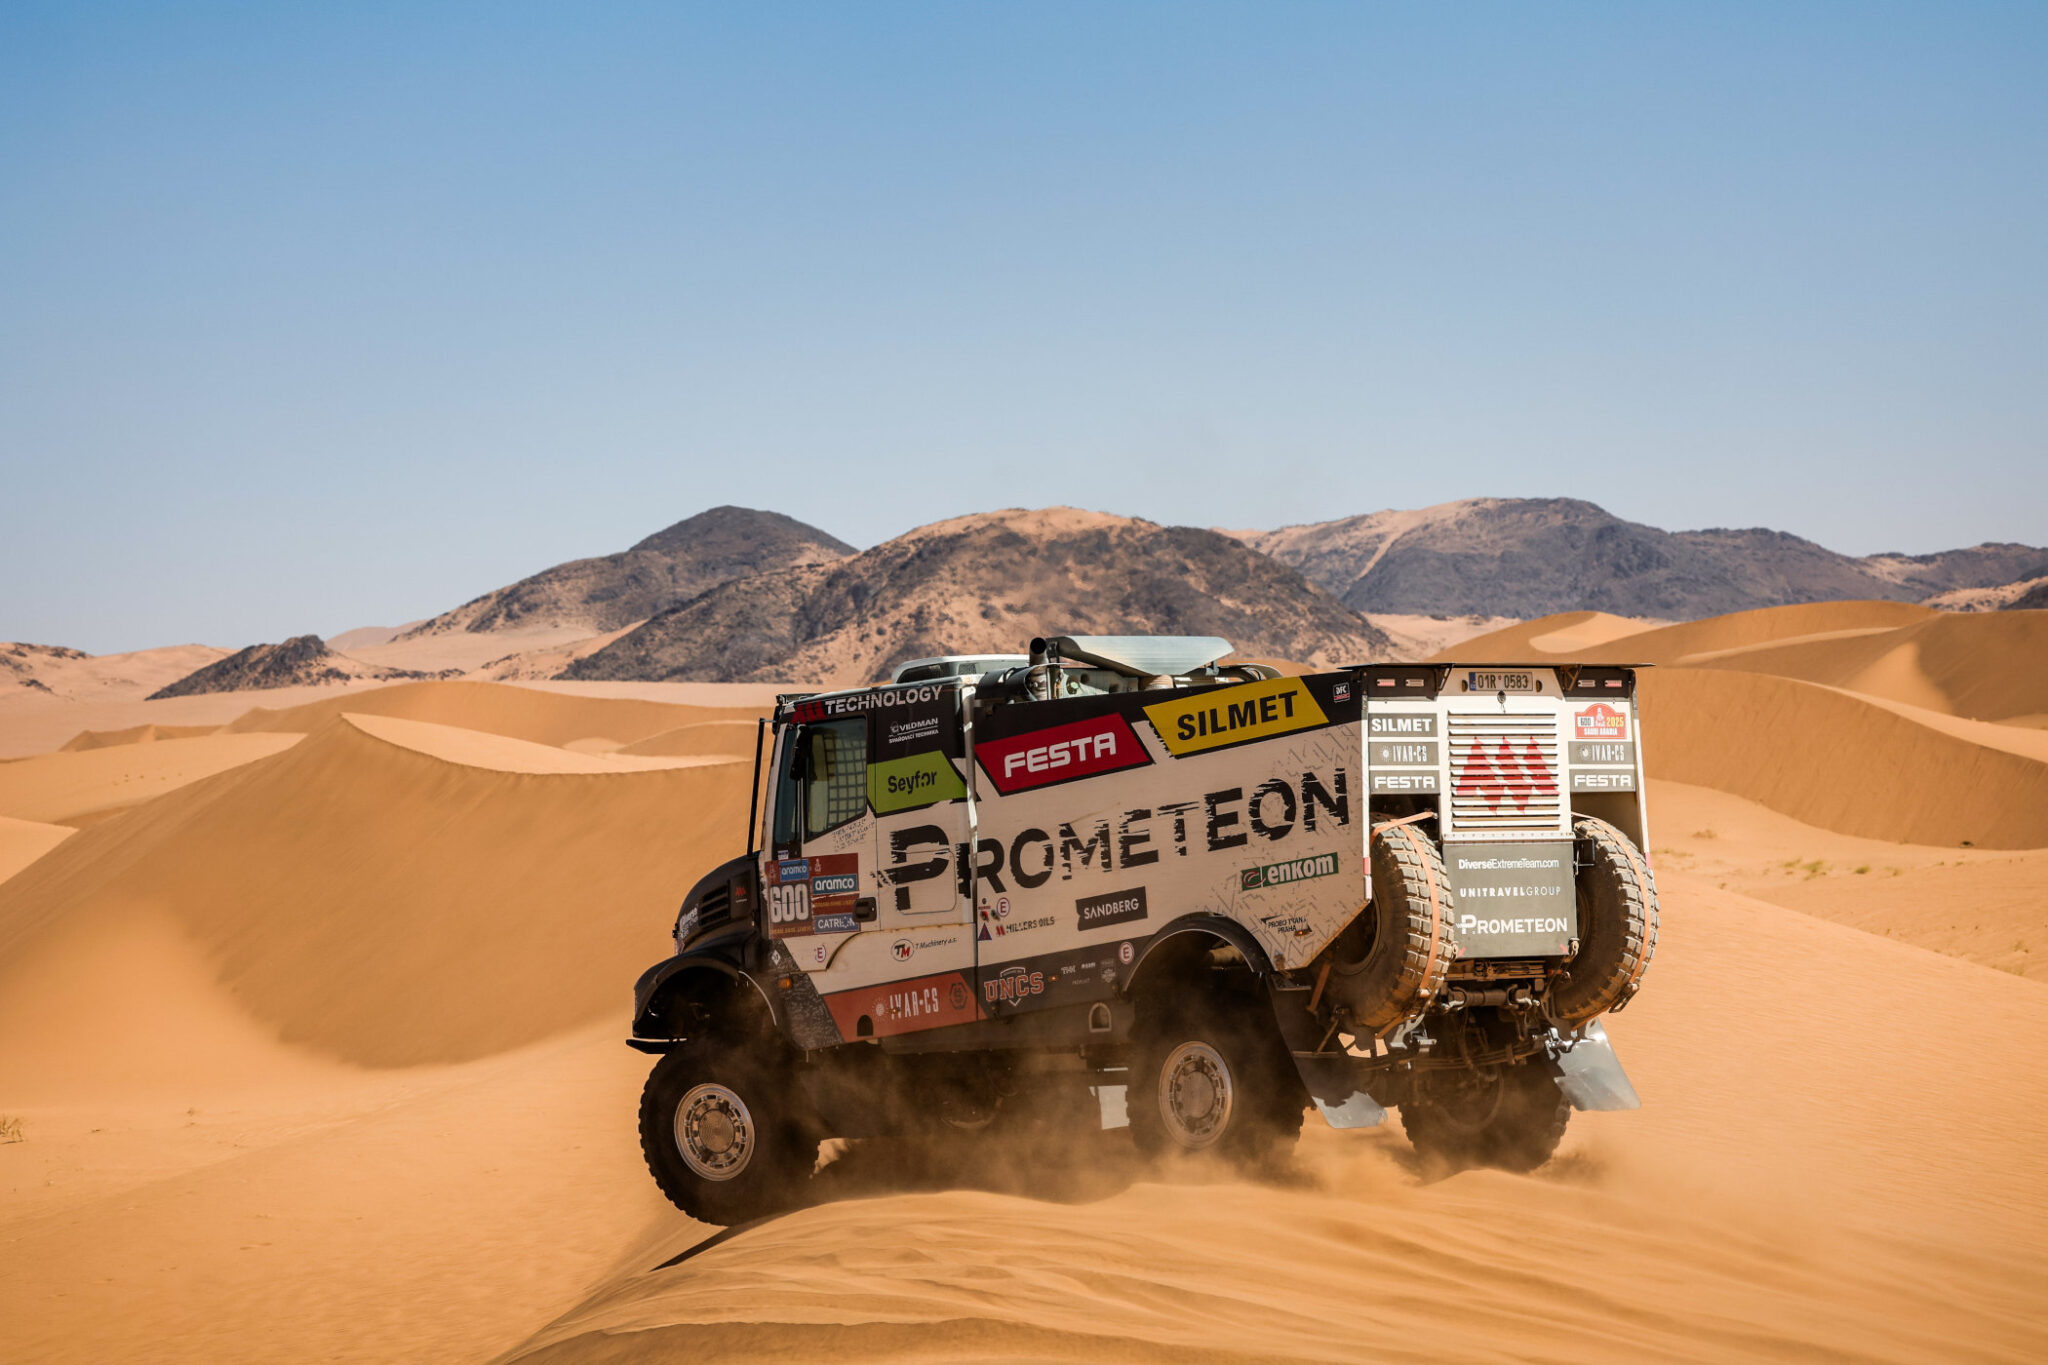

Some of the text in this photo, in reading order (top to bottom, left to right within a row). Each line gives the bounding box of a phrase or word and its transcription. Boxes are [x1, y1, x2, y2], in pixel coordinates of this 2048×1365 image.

[1477, 674, 1496, 689] 01R
[1504, 674, 1528, 689] 0583
[825, 685, 943, 714] TECHNOLOGY
[1177, 690, 1299, 741] SILMET
[1606, 716, 1625, 727] 2025
[1371, 718, 1432, 732] SILMET
[1004, 731, 1117, 778] FESTA
[887, 769, 937, 795] Seyfor
[1374, 775, 1435, 789] FESTA
[1574, 774, 1632, 787] FESTA
[887, 767, 1349, 911] PROMETEON
[781, 865, 807, 875] aramco
[1267, 855, 1334, 884] enkom
[1458, 858, 1560, 869] DiverseExtremeTeam.com
[815, 878, 855, 891] aramco
[770, 884, 809, 923] 600
[1084, 898, 1140, 920] SANDBERG
[1039, 916, 1055, 928] OILS
[1461, 914, 1568, 934] PROMETEON
[894, 944, 911, 958] TM
[984, 972, 1044, 1001] UNCS
